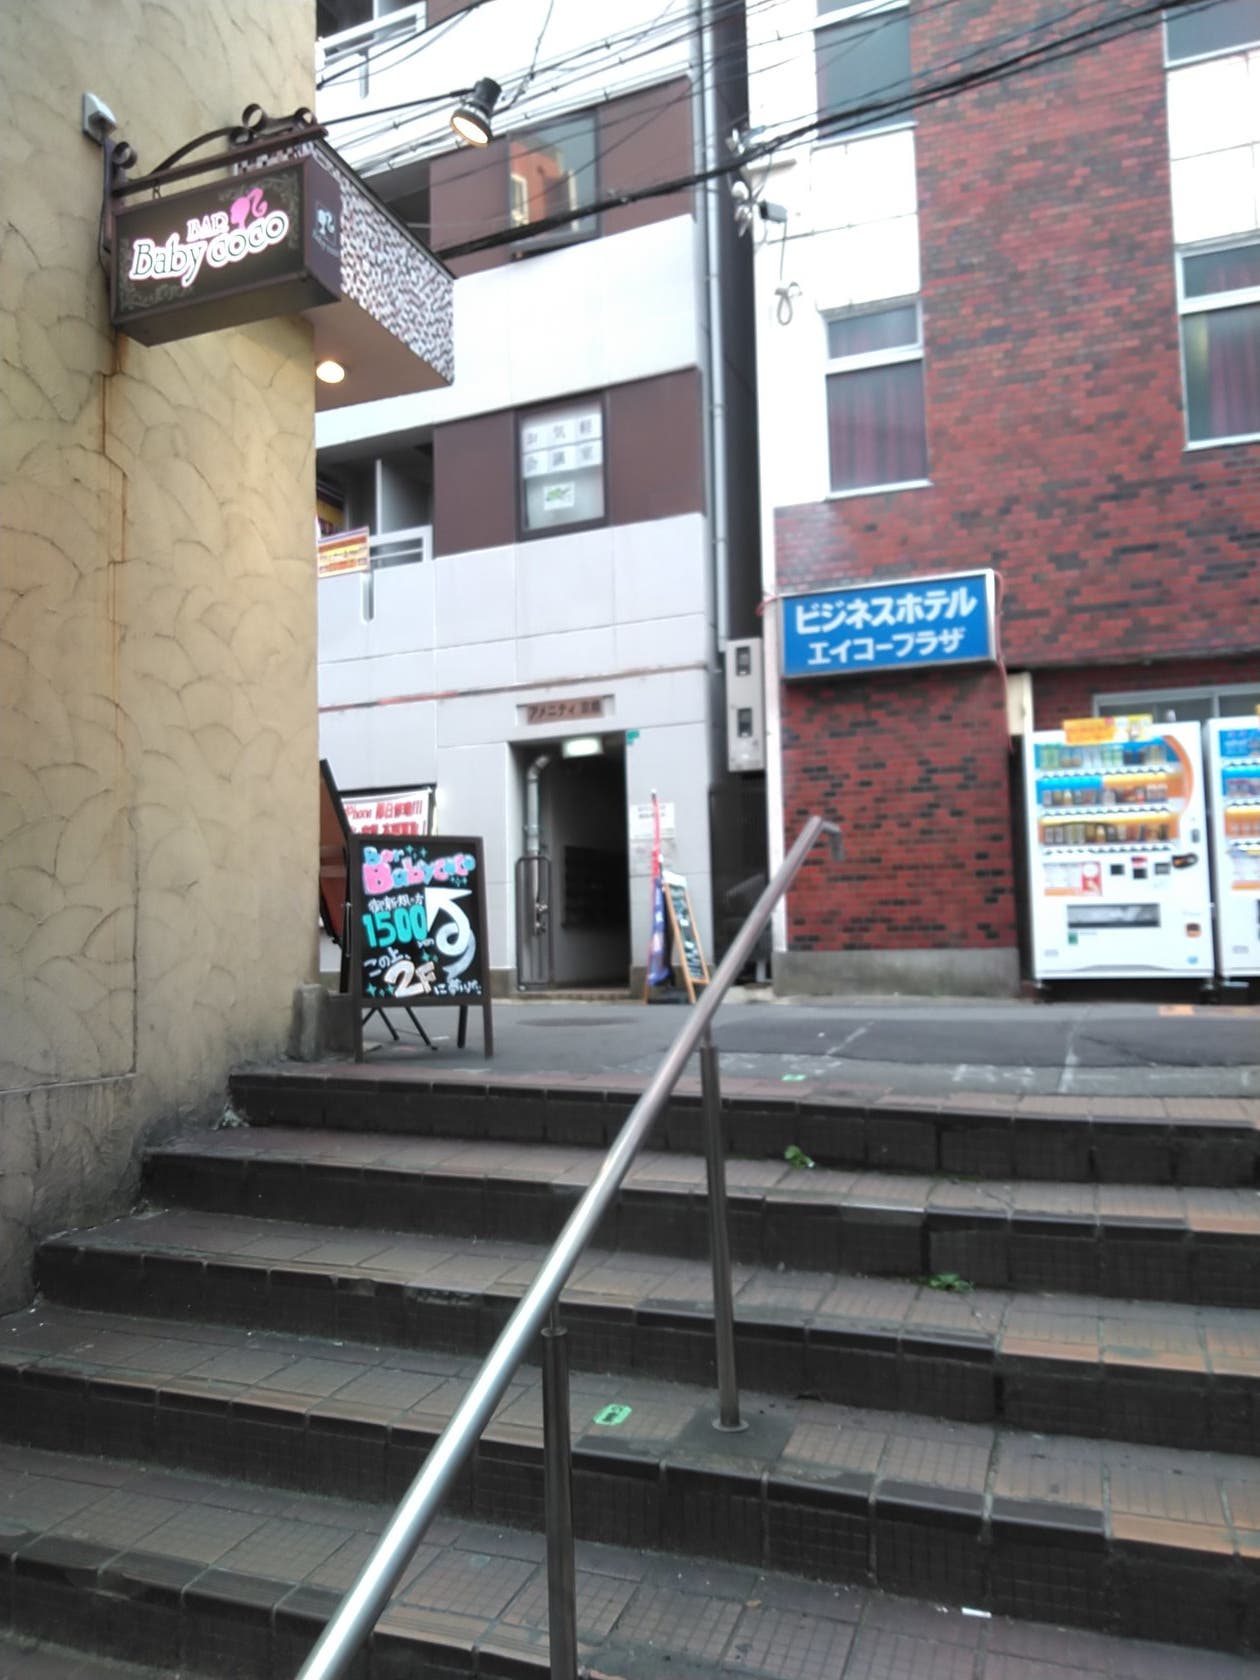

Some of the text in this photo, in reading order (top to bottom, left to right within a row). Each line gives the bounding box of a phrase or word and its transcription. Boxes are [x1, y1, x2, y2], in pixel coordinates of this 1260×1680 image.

[795, 586, 978, 635] ビジネスホテル
[807, 626, 966, 666] エイコープラザ
[362, 903, 428, 948] 1500
[383, 960, 437, 999] 2F
